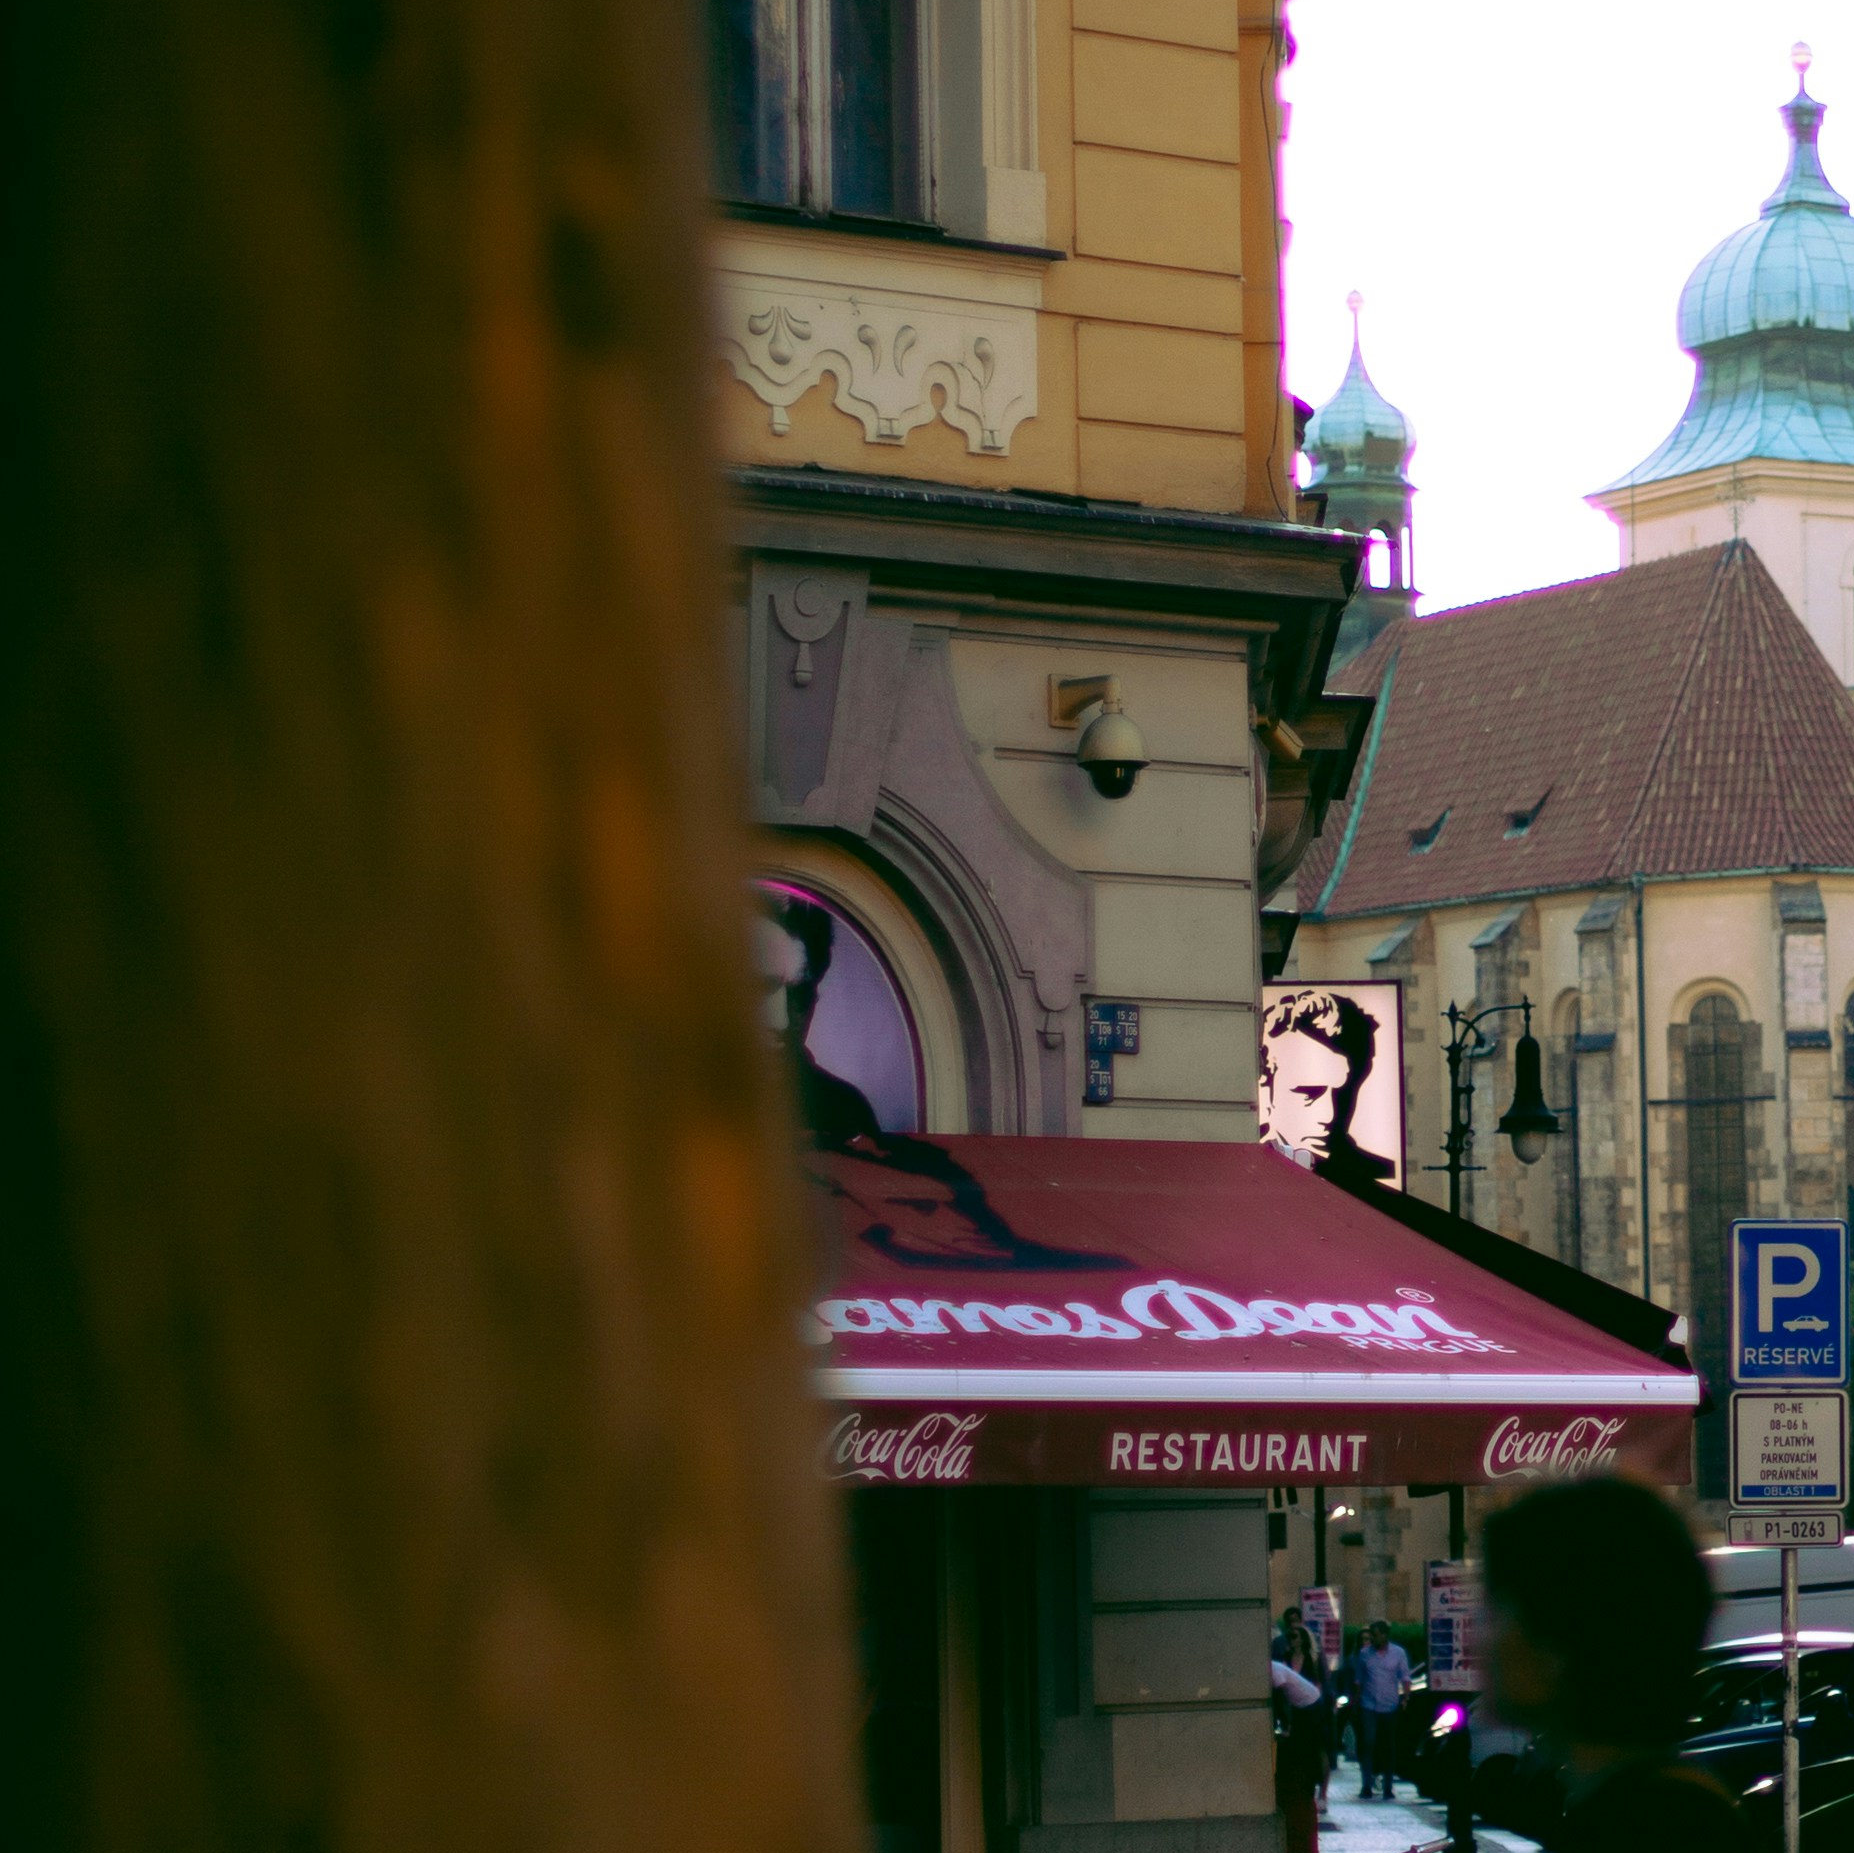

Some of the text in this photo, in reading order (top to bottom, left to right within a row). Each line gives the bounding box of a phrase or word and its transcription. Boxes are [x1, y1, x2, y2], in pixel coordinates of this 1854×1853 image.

[1757, 1243, 1821, 1333] P
[812, 1278, 1477, 1344] ames Dean
[1348, 1333, 1518, 1354] PRAGUE
[1744, 1343, 1836, 1366] RÉSERVÉ
[1774, 1402, 1804, 1415] PO-NE
[1802, 1419, 1808, 1431] h
[1763, 1433, 1815, 1448] S PLATNÝM
[1110, 1432, 1369, 1474] RESTAURANT
[1761, 1449, 1817, 1464] PARKOVACÍM
[1760, 1466, 1819, 1481] OPRÁVNĚNÍM
[1763, 1485, 1816, 1497] OBLAST 1
[1765, 1521, 1826, 1539] P1-0263
